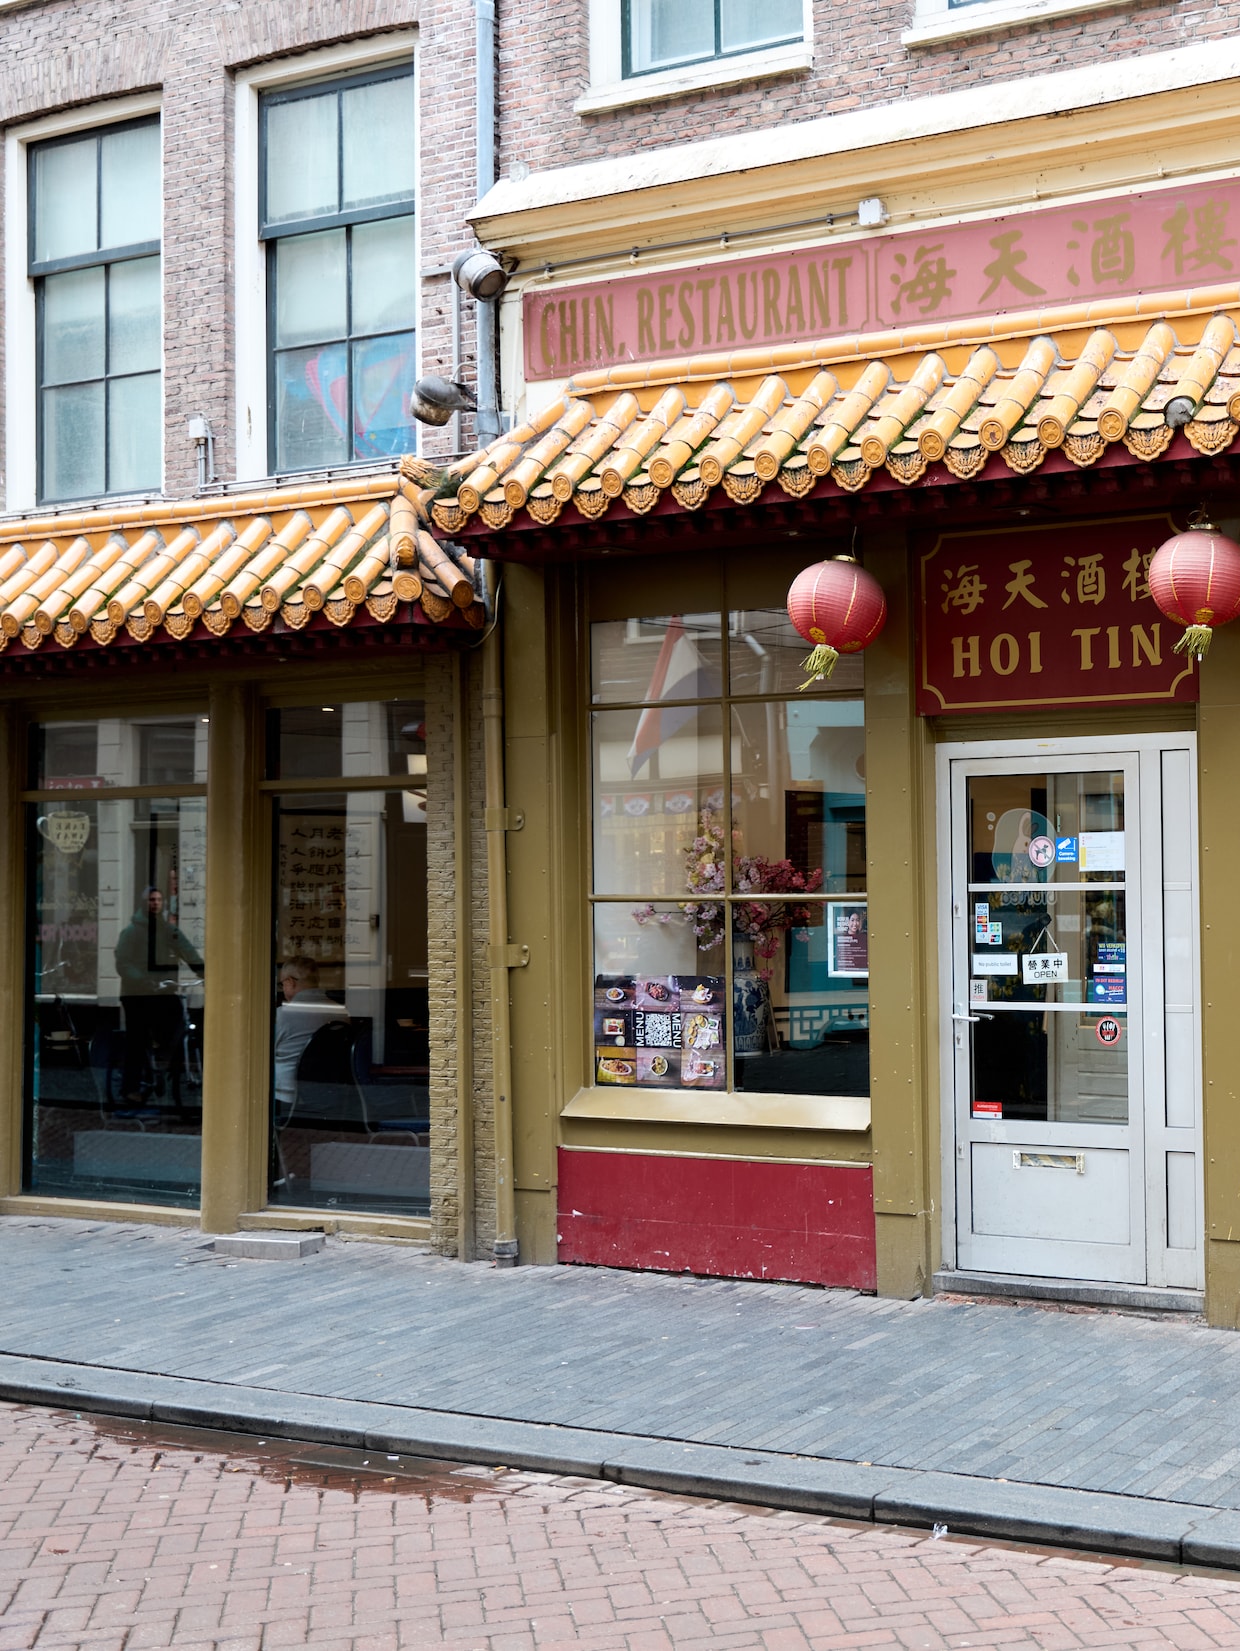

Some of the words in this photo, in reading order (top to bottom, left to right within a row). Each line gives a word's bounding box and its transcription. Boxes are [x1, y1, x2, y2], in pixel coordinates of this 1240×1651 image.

[890, 198, 1240, 317] 海天酒樓
[637, 256, 855, 354] RESTAURANT
[951, 631, 1043, 678] HOI
[1071, 622, 1163, 672] TIN
[1027, 958, 1064, 971] 營業中
[1033, 971, 1058, 980] OPEN
[973, 983, 985, 994] 推
[635, 1012, 645, 1047] MENU
[671, 1013, 682, 1048] MENU
